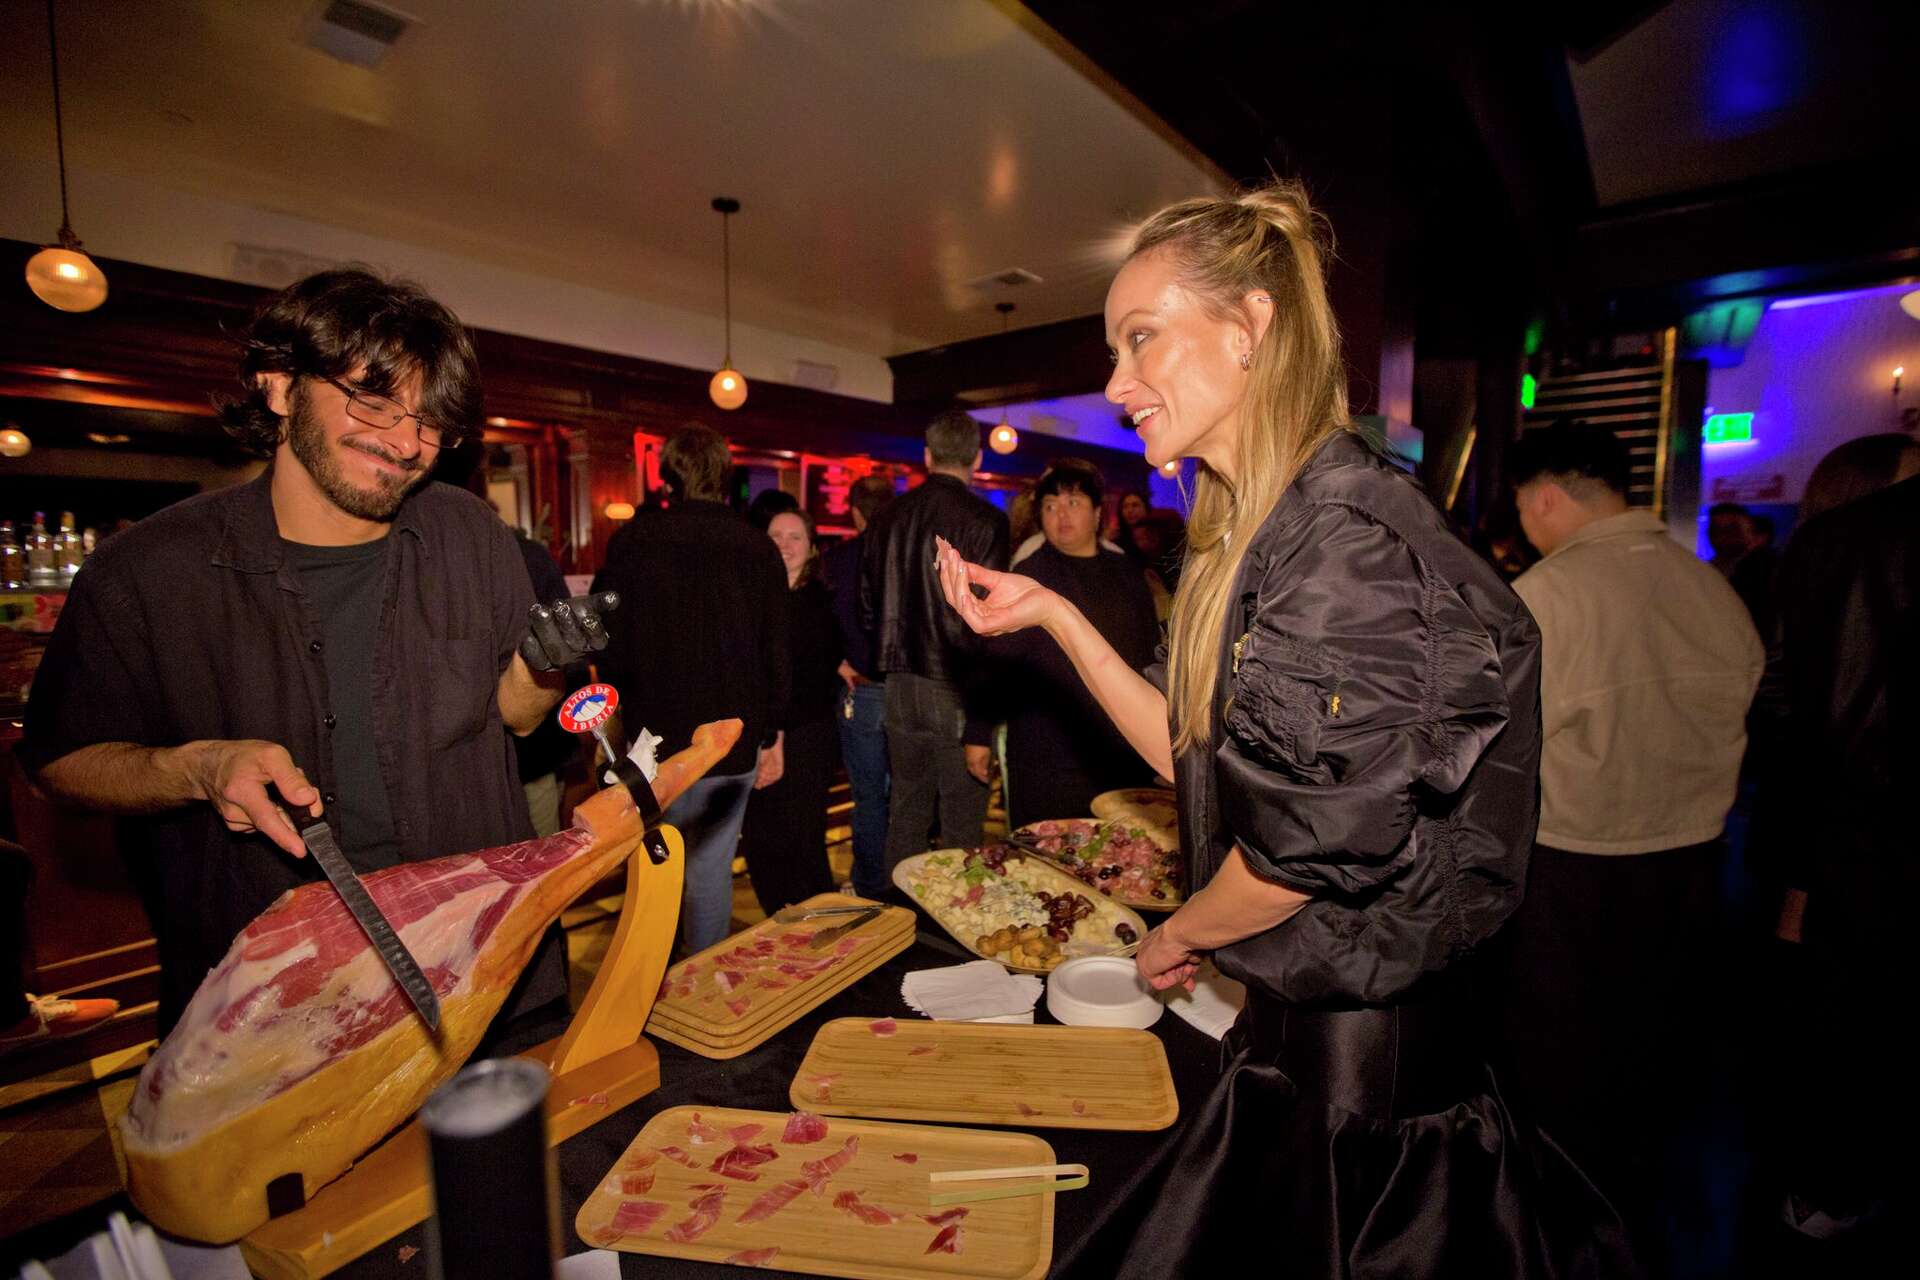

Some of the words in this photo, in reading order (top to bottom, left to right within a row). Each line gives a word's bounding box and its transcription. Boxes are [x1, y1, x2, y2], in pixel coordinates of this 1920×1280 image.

[564, 688, 592, 718] ALTOS
[595, 686, 610, 696] DE
[572, 705, 614, 730] IBERIA
